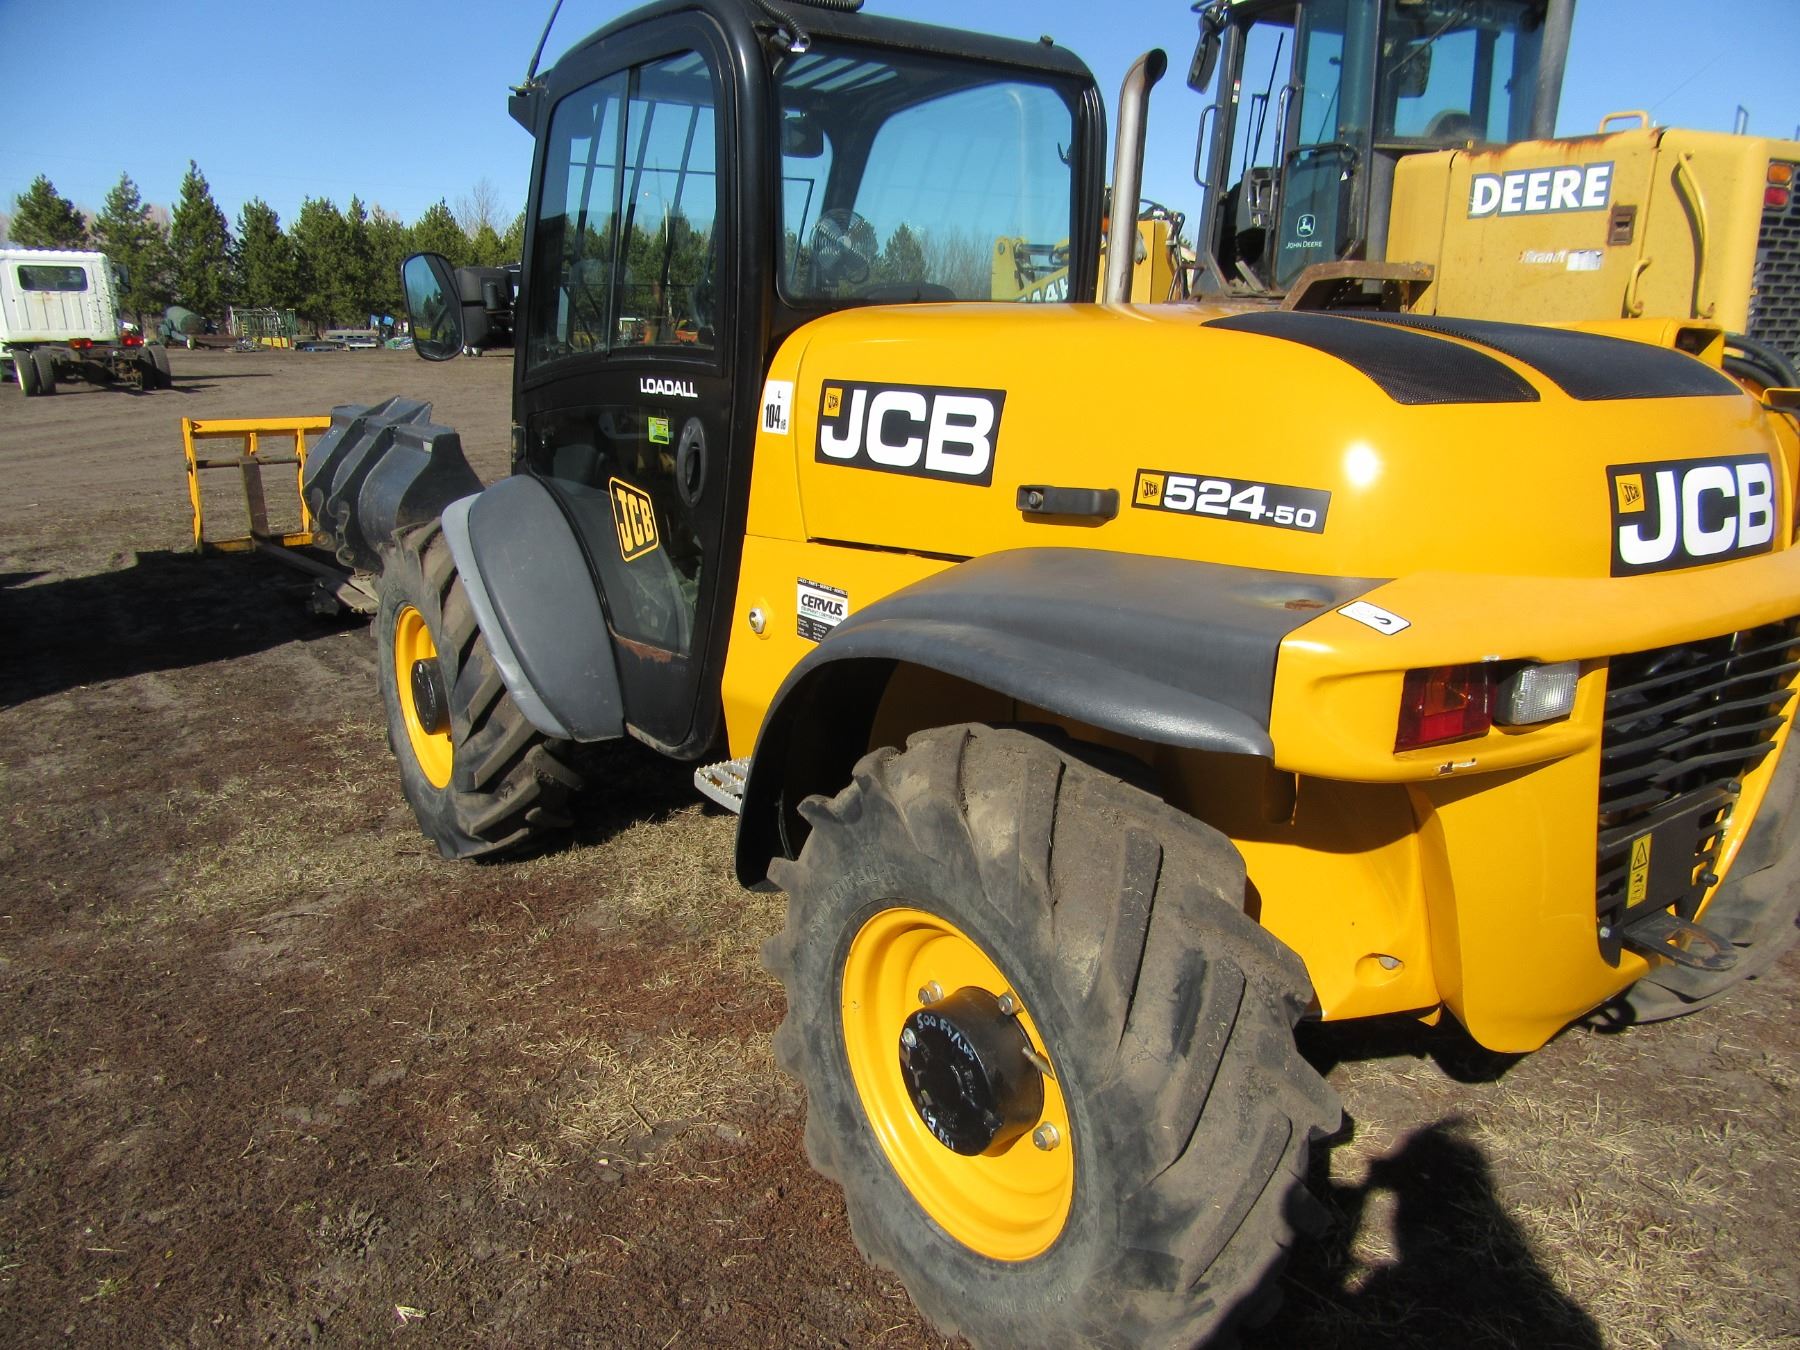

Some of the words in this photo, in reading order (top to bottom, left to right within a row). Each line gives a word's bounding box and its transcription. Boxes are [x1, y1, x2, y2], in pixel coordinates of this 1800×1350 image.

[1471, 166, 1610, 215] DEERE
[1286, 241, 1302, 249] JOHN
[640, 378, 698, 398] LOADALL
[828, 393, 839, 410] JCB
[766, 403, 781, 429] 104
[821, 389, 994, 476] JCB
[1144, 480, 1159, 497] JCB
[1624, 484, 1640, 503] JCB
[616, 487, 655, 552] JCB
[1619, 463, 1773, 565] JCB
[801, 594, 843, 616] CERVUS
[917, 1013, 936, 1030] 500
